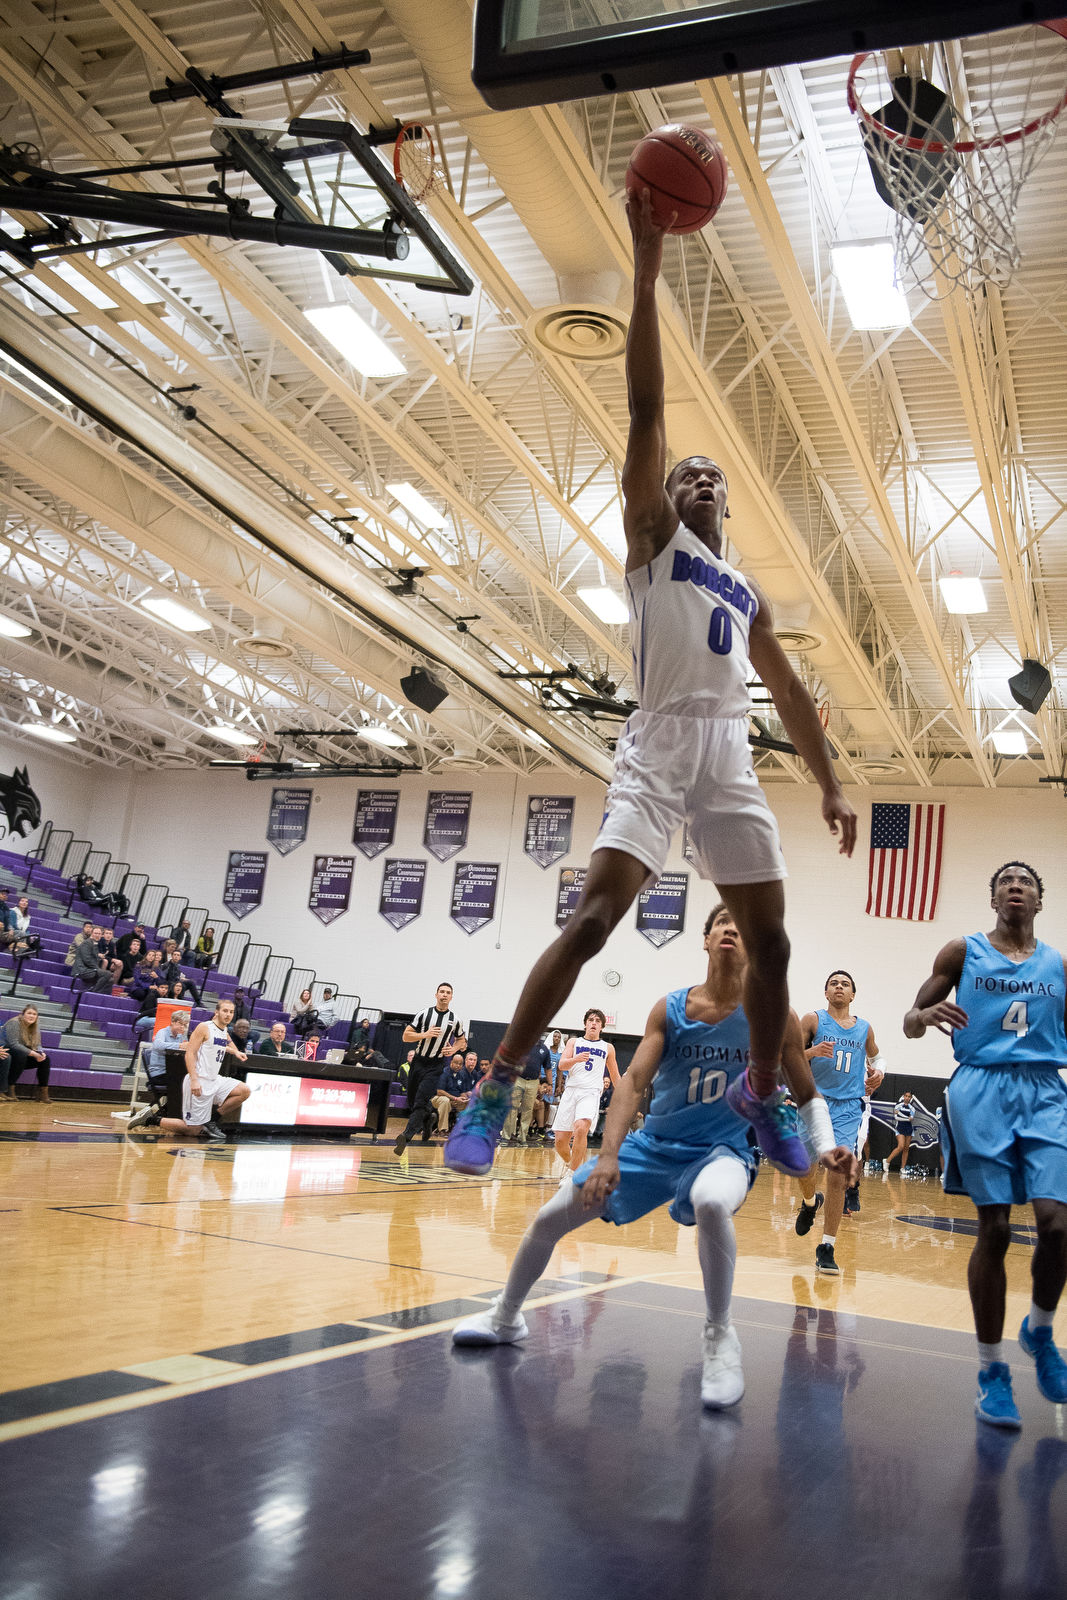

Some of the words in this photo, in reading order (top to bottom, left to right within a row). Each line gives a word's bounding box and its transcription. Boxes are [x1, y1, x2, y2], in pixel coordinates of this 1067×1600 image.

[708, 607, 732, 655] 0
[327, 858, 352, 866] Baseball
[975, 977, 1056, 998] POTOMAC
[1001, 1000, 1029, 1038] 4
[823, 1035, 864, 1050] POTOMAC
[585, 1058, 594, 1071] 5
[835, 1050, 853, 1074] 11
[687, 1065, 728, 1105] 10
